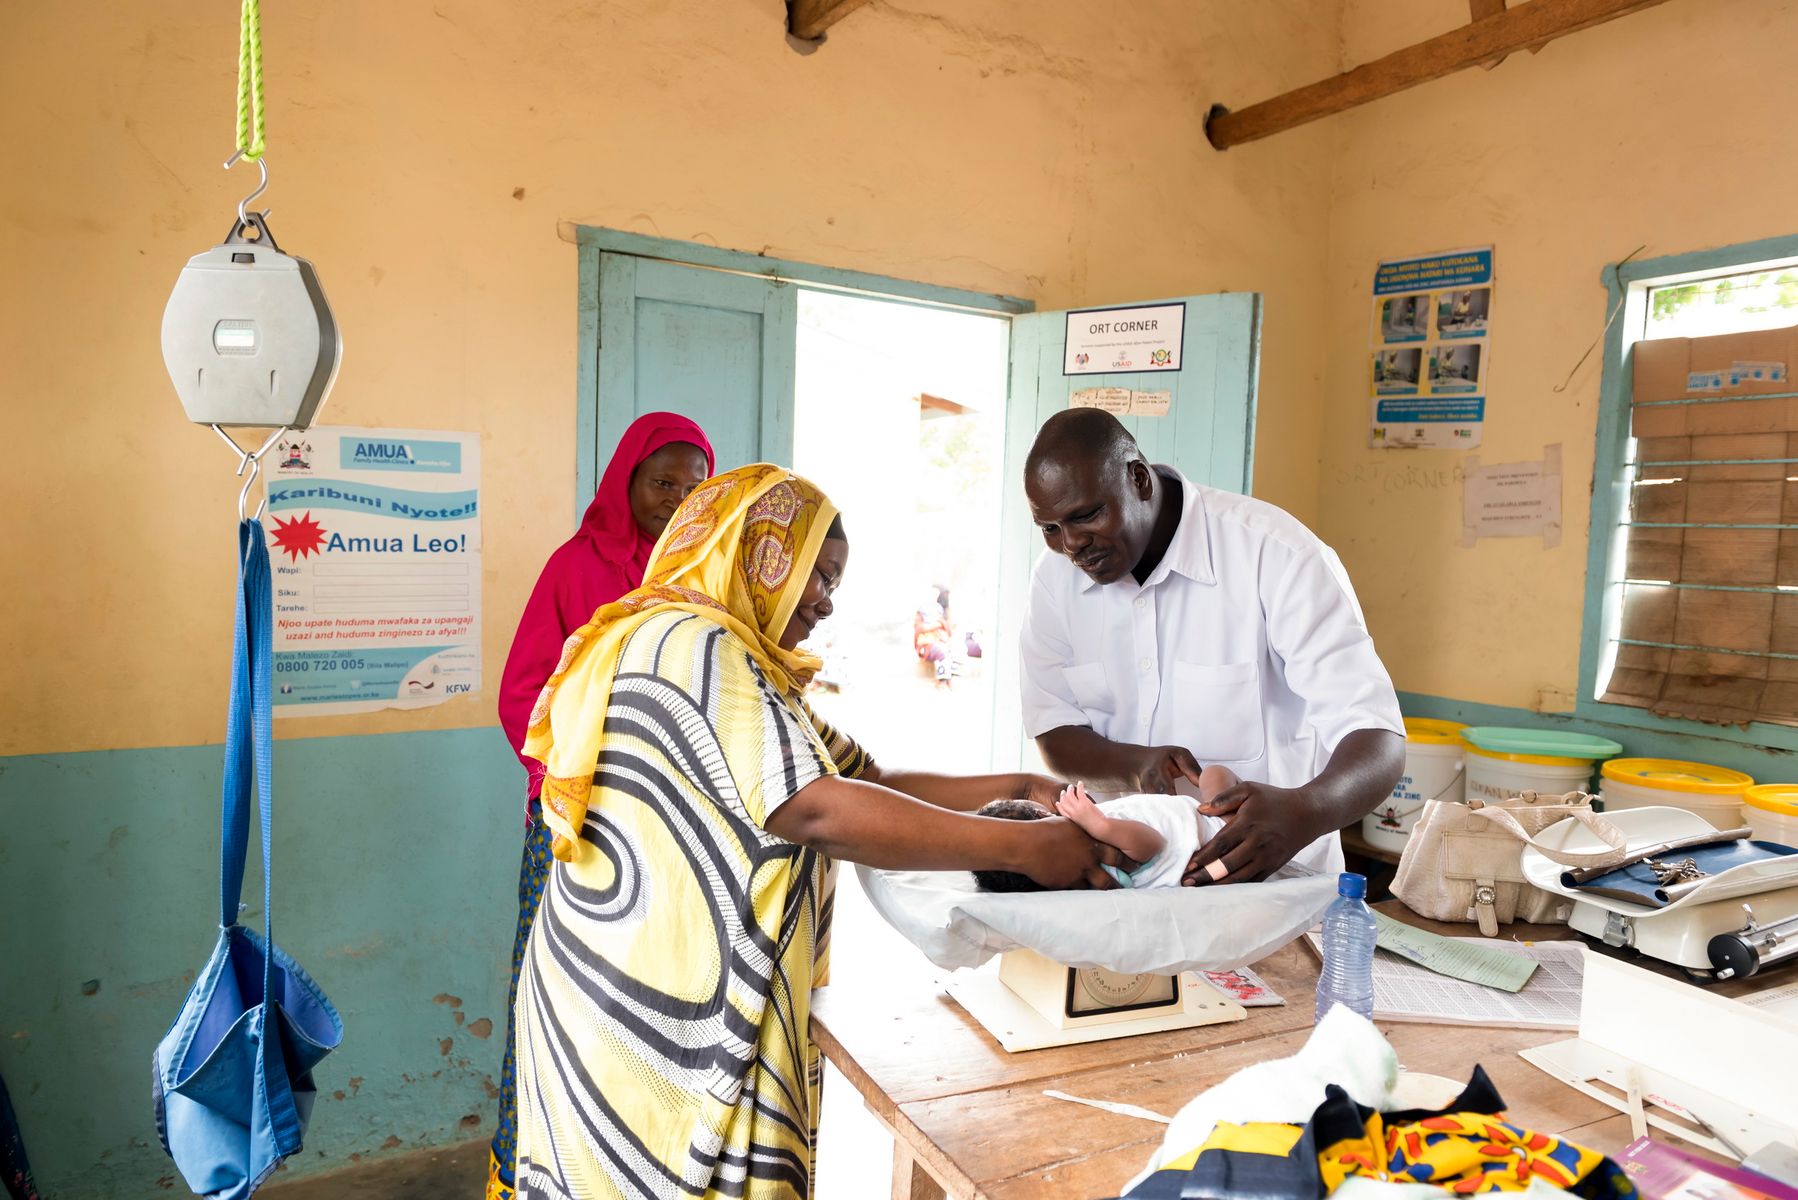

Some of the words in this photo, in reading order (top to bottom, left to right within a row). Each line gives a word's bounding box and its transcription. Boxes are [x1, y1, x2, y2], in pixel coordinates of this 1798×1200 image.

[1089, 323, 1111, 335] ORT
[1113, 319, 1158, 333] CORNER
[269, 487, 381, 508] Karibuni
[391, 501, 477, 518] Nyote!!
[327, 533, 403, 553] Amua
[413, 533, 466, 553] Leo!
[277, 567, 302, 576] Wapi:
[276, 604, 308, 612] Tarehe:
[277, 619, 302, 630] Njoo
[304, 619, 333, 629] upate
[335, 618, 375, 626] huduma
[378, 617, 419, 625] mwafaka
[434, 616, 474, 625] upangaji
[286, 631, 312, 640] uzazi
[315, 631, 334, 639] and
[336, 630, 376, 638] huduma
[378, 629, 423, 639] zinginezo
[438, 627, 467, 637] afya!!!
[276, 651, 295, 660] Kwa
[276, 661, 309, 673] 0800
[313, 660, 337, 671] 720
[341, 659, 365, 670] 005
